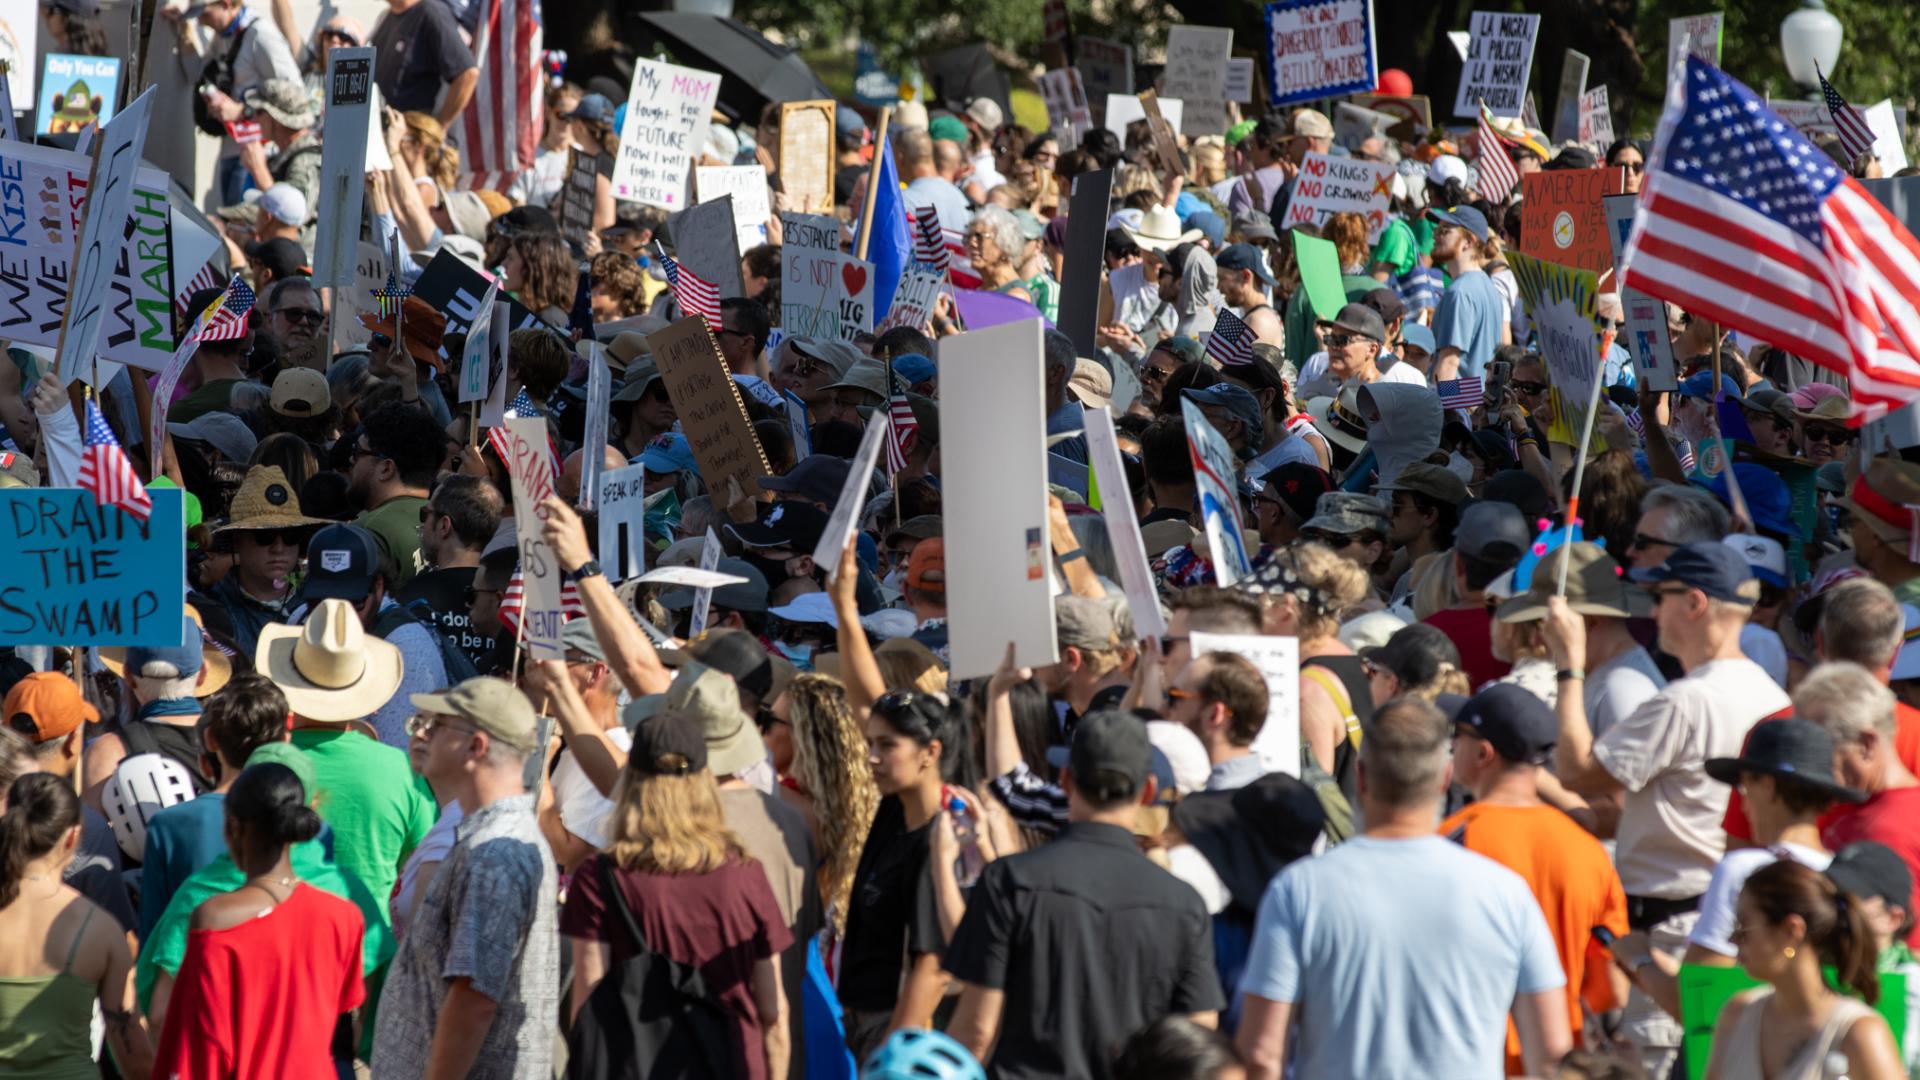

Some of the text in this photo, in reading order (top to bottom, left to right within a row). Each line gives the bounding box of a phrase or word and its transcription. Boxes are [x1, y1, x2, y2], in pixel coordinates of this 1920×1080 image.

[1481, 15, 1494, 36] LA
[48, 58, 116, 78] Only You Can
[1472, 62, 1486, 83] LA
[638, 66, 712, 102] My MOM
[637, 125, 687, 151] FUTURE
[1305, 158, 1369, 183] NO KINGS
[1297, 180, 1372, 203] NO CROWNS
[1525, 171, 1612, 208] AMERICA
[1290, 203, 1315, 223] NO
[133, 188, 175, 353] MARCH
[789, 255, 837, 289] IS NOT
[602, 476, 645, 505] SPEAK UP!
[10, 494, 155, 545] DRAIN
[21, 546, 122, 590] THE
[0, 586, 158, 638] SWAMP
[462, 631, 482, 648] be
